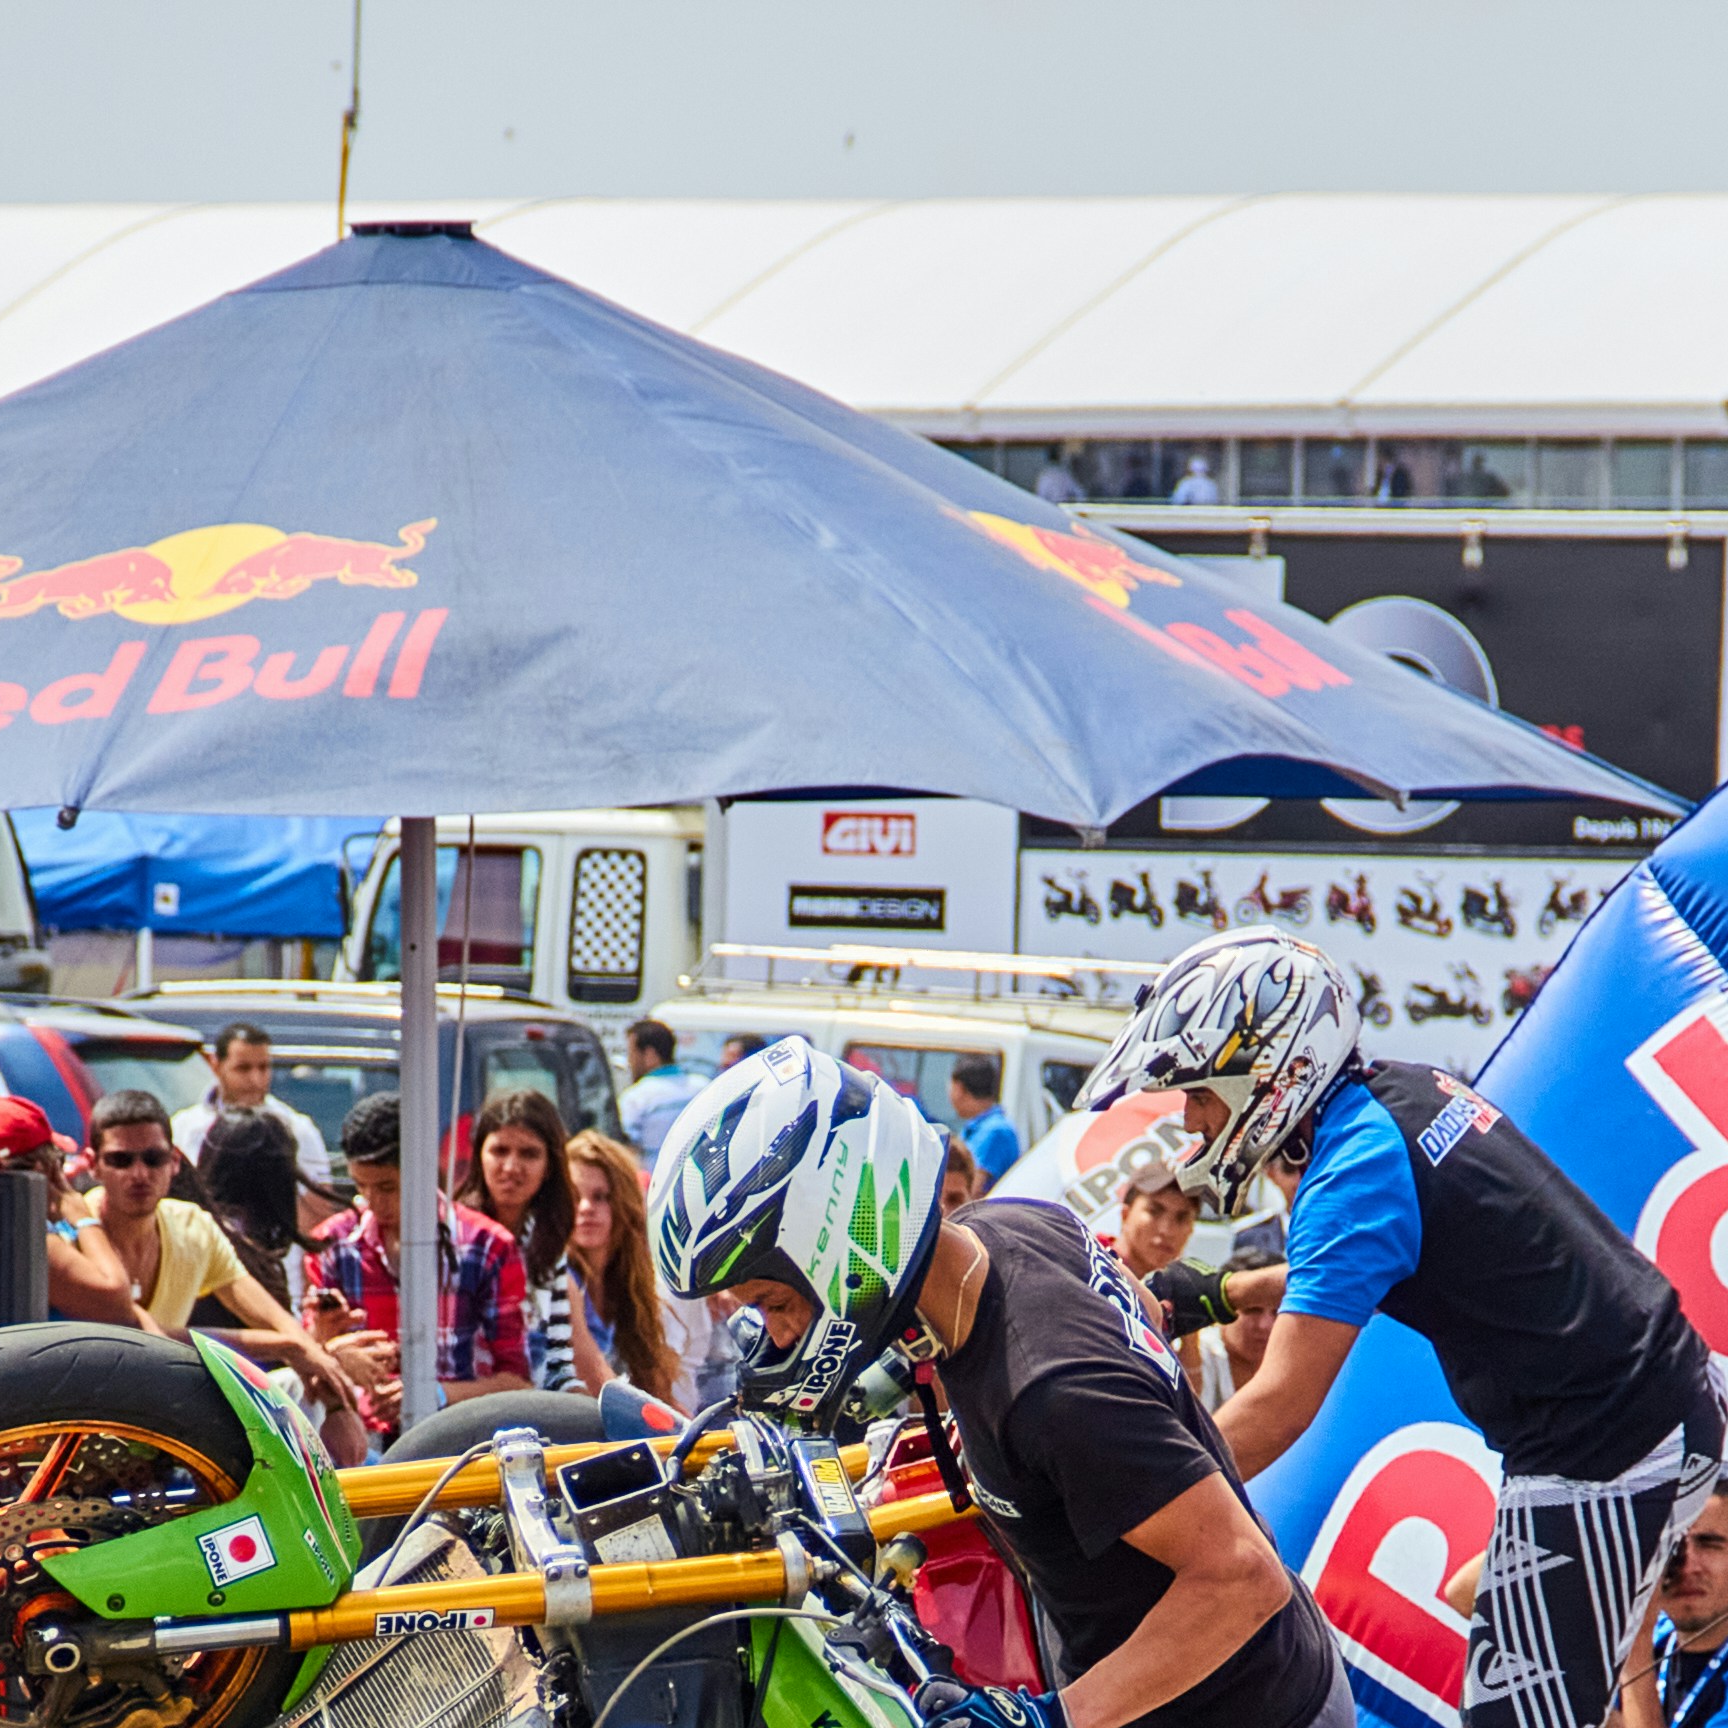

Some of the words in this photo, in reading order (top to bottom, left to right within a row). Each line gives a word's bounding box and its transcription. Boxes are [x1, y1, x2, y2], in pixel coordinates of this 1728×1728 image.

[146, 607, 450, 715] Bull
[826, 817, 913, 853] GIVI
[805, 1138, 850, 1281] kenny
[801, 1321, 855, 1394] IPONE
[202, 1537, 228, 1583] IPONE
[378, 1612, 468, 1635] IPONE
